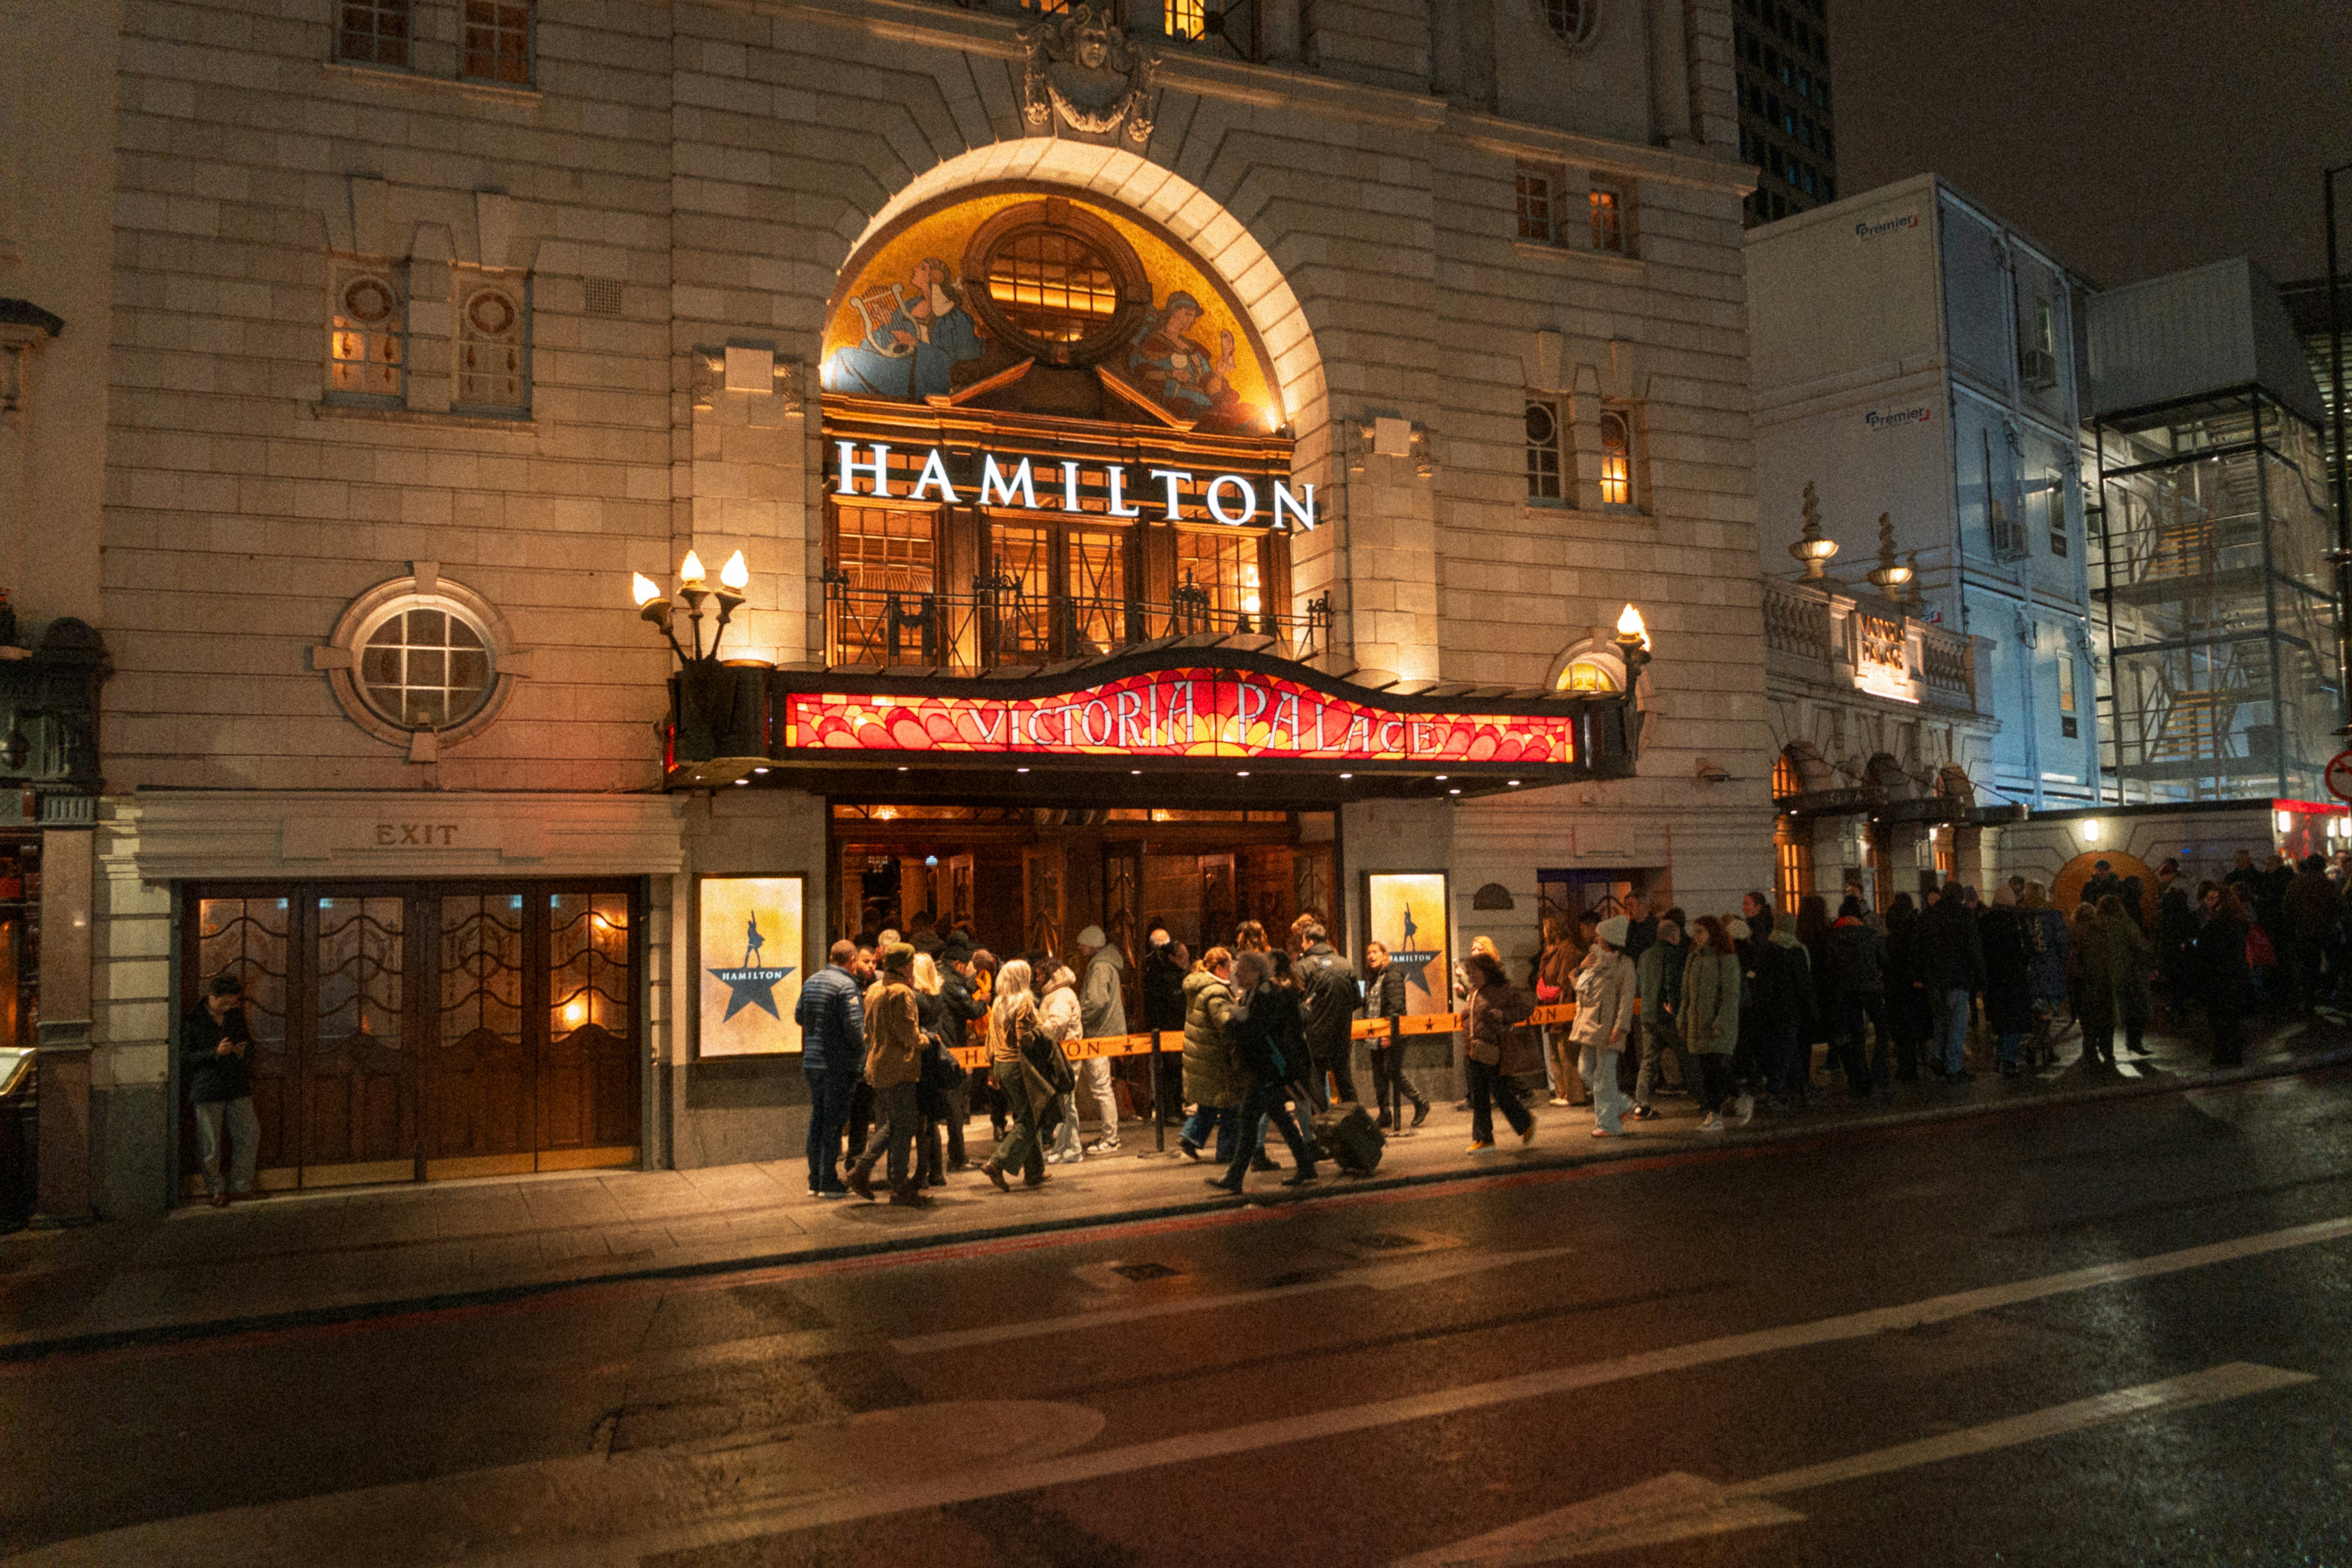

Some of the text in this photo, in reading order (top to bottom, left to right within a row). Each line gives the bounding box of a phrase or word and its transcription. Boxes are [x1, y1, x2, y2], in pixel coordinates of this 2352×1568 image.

[835, 441, 1316, 531] HAMILTON
[967, 681, 1436, 753] VICTORIA PALACE
[377, 825, 458, 845] EXIT
[722, 971, 782, 981] HAMILTON
